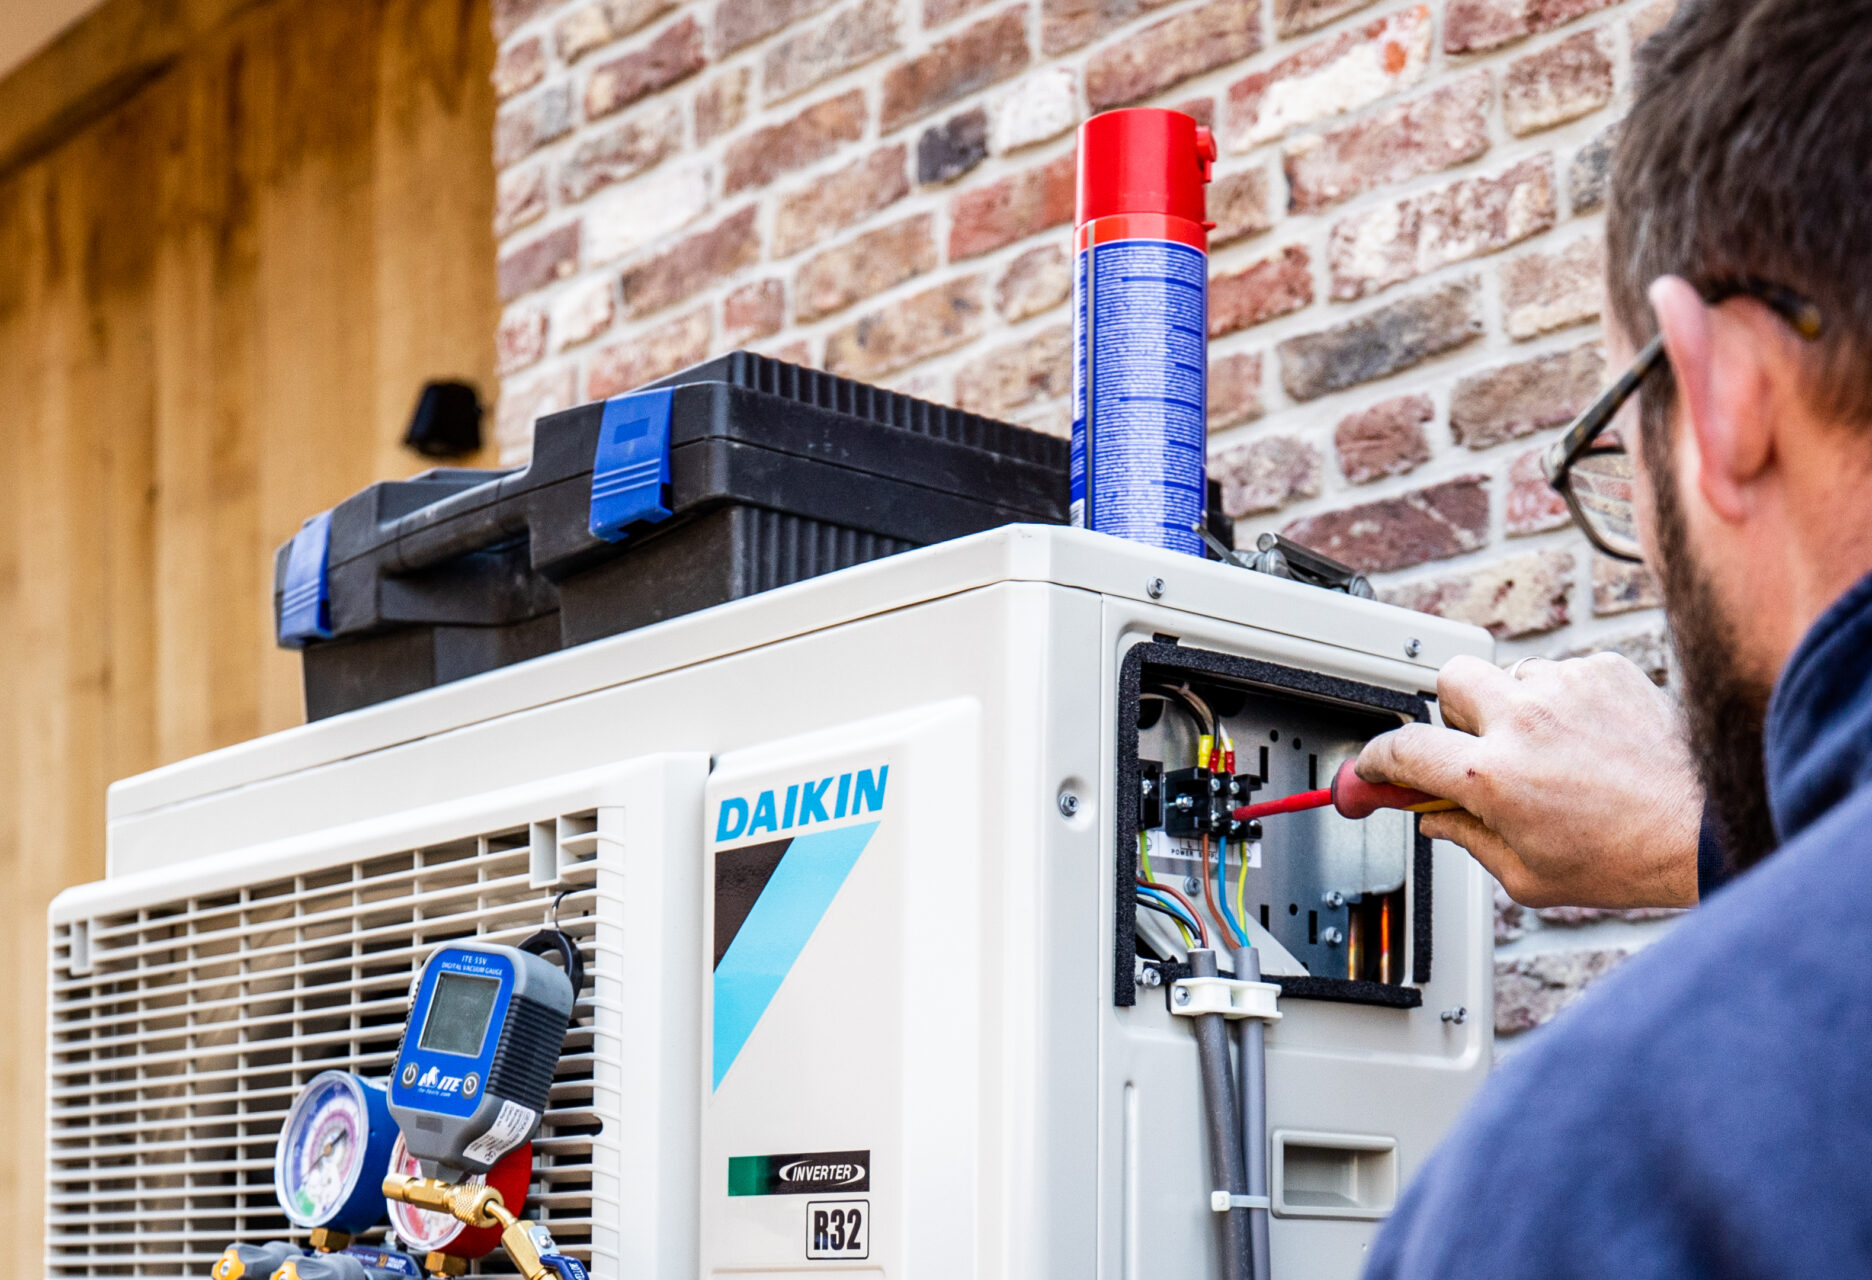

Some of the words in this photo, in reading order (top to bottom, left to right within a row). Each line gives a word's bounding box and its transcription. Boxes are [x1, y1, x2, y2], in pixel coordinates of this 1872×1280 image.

[715, 764, 889, 843] DAIKIN
[1171, 848, 1194, 858] POWER
[441, 961, 462, 971] DIGITAL
[462, 964, 485, 974] VACUUM
[485, 967, 503, 976] GAUGE
[437, 1075, 463, 1092] ITE
[792, 1164, 852, 1182] INVERTER
[813, 1208, 862, 1251] R32
